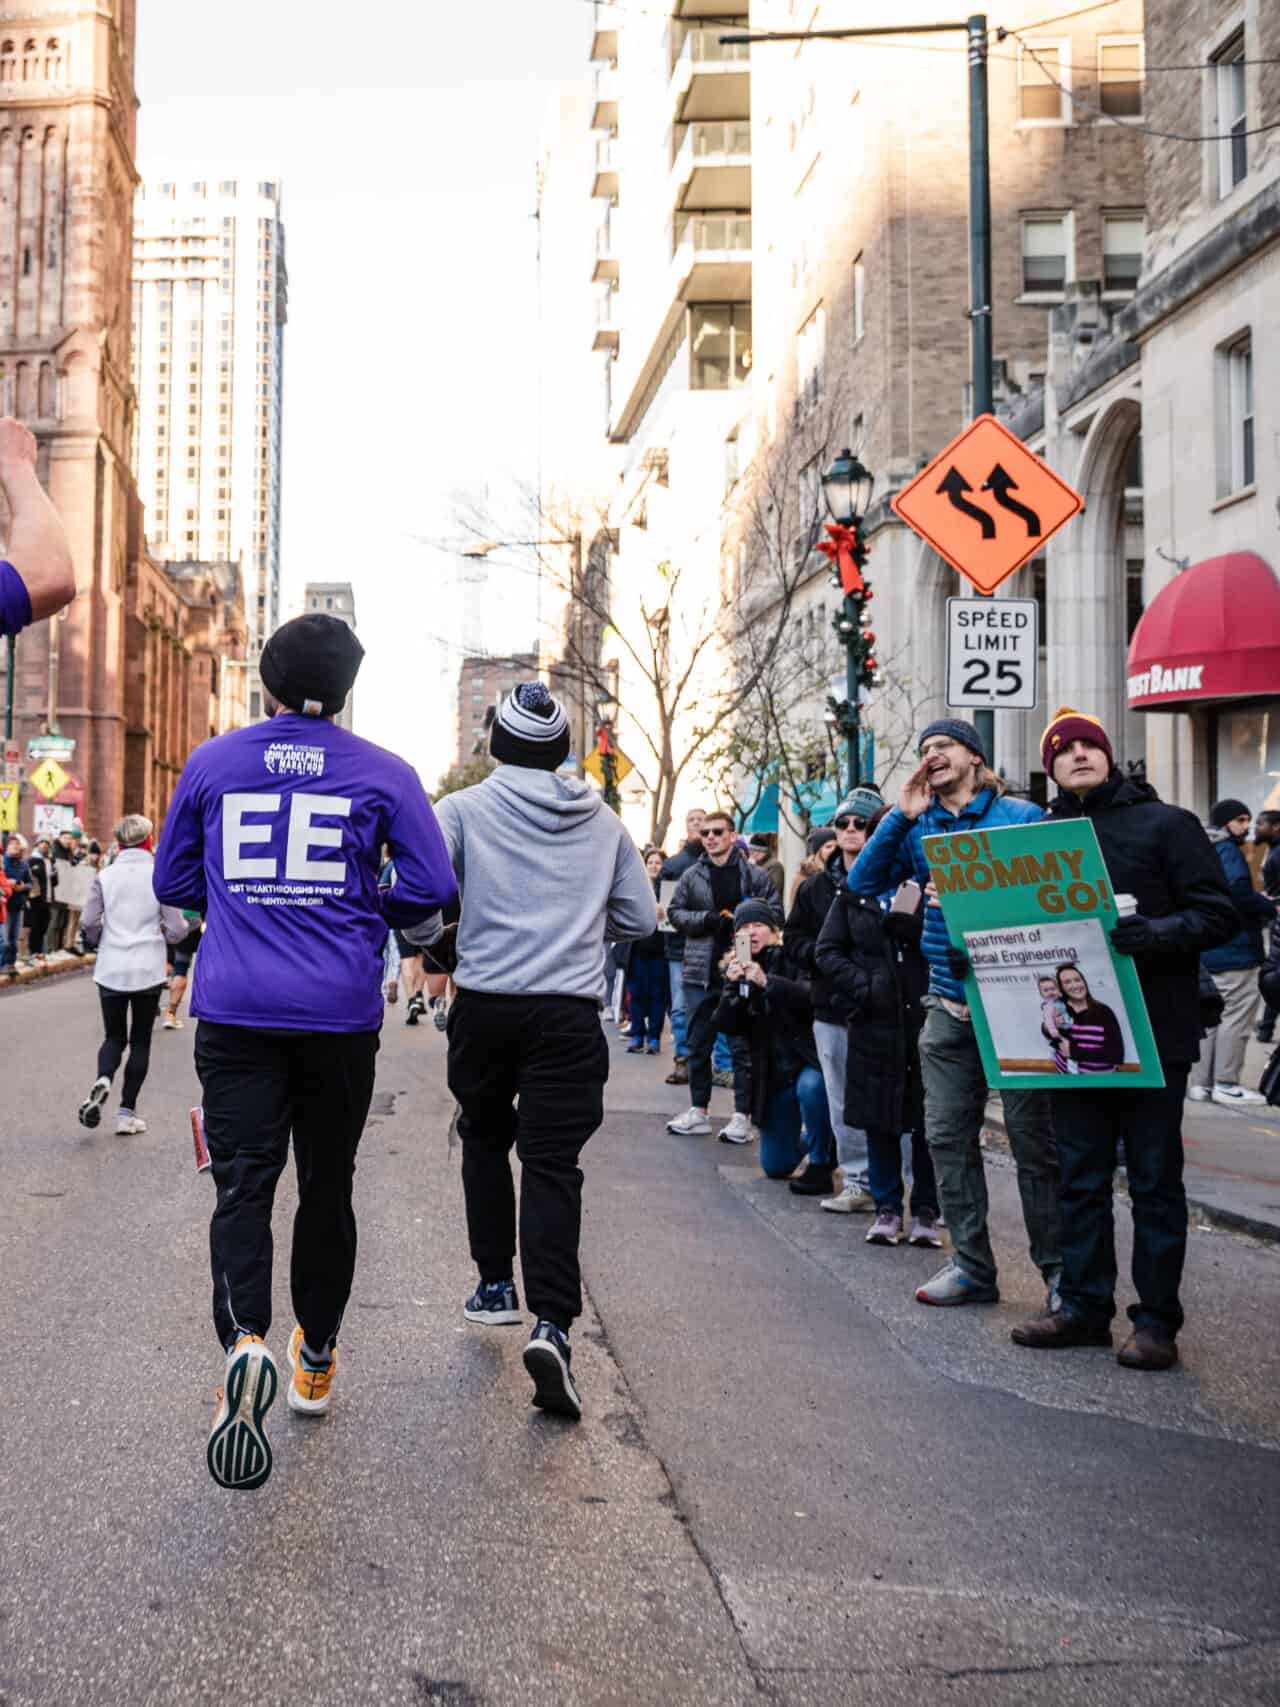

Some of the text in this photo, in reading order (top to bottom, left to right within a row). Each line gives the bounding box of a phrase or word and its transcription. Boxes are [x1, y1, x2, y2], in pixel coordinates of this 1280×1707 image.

[957, 611, 1028, 628] SPEED
[964, 634, 1021, 651] LIMIT
[962, 659, 1022, 696] 25
[223, 792, 352, 882] EE
[924, 831, 992, 864] GO!
[931, 848, 1084, 894] MOMMY
[1037, 880, 1111, 913] GO!
[1028, 929, 1042, 943] of
[1001, 946, 1078, 965] Engineering
